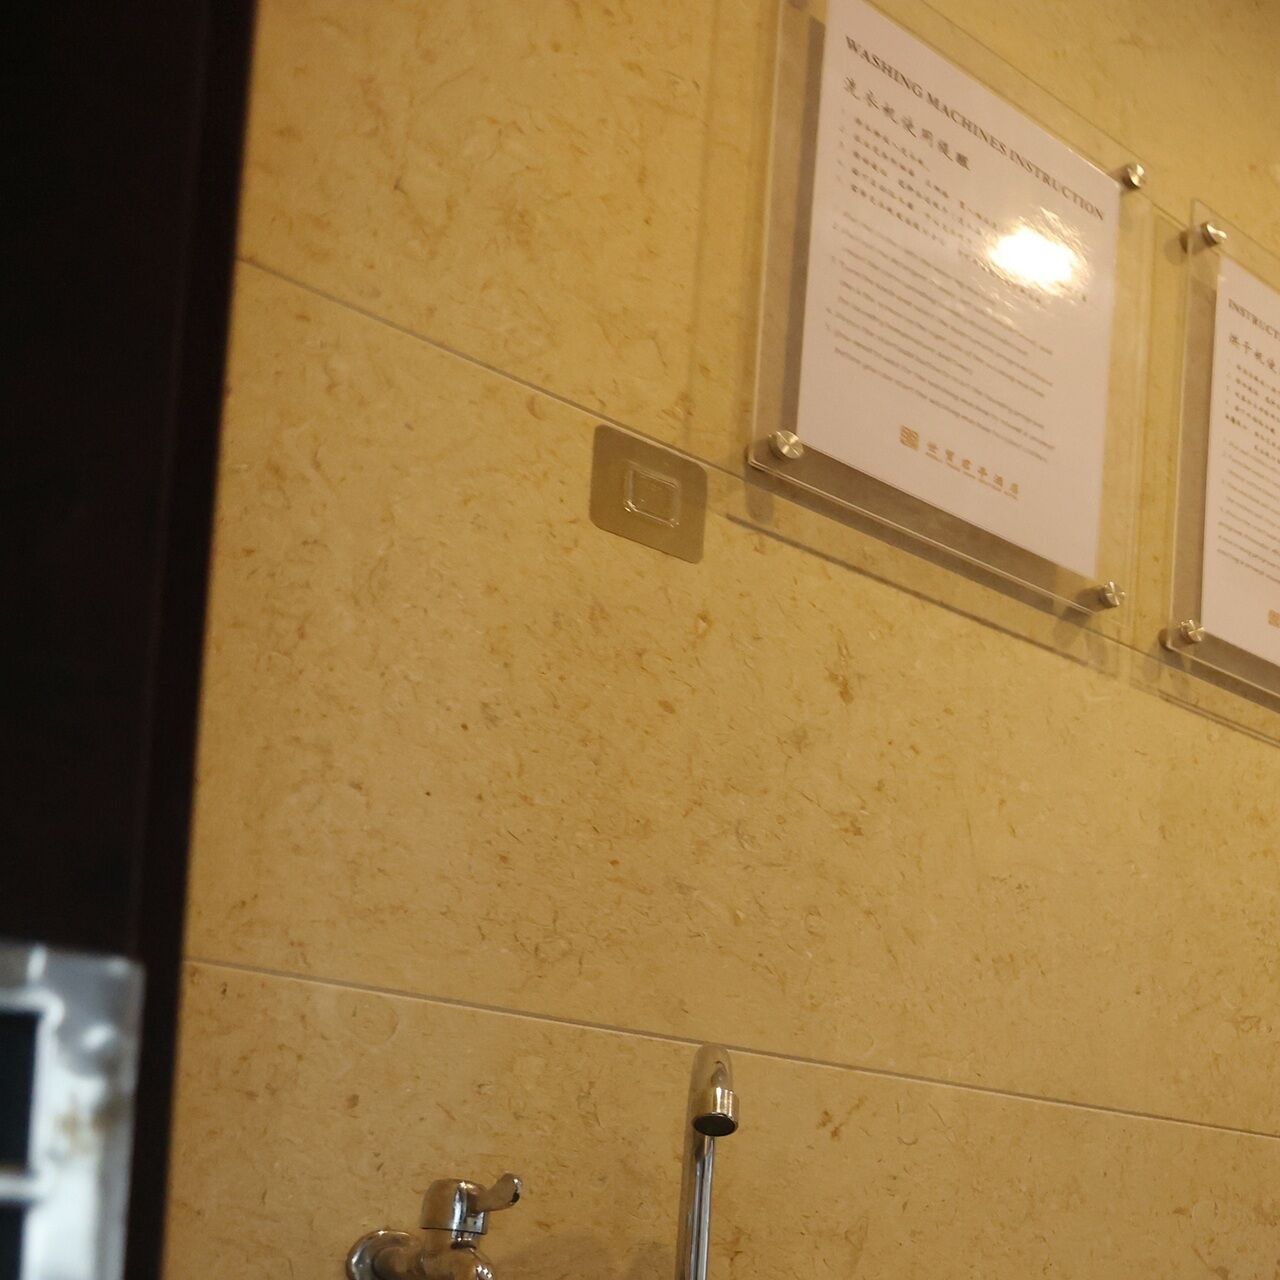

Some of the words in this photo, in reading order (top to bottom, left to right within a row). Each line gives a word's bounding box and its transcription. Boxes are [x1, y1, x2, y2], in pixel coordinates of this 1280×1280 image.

[845, 35, 923, 98] WASHING
[927, 92, 1006, 155] MACHINES
[1009, 151, 1104, 221] INSTRUCTION
